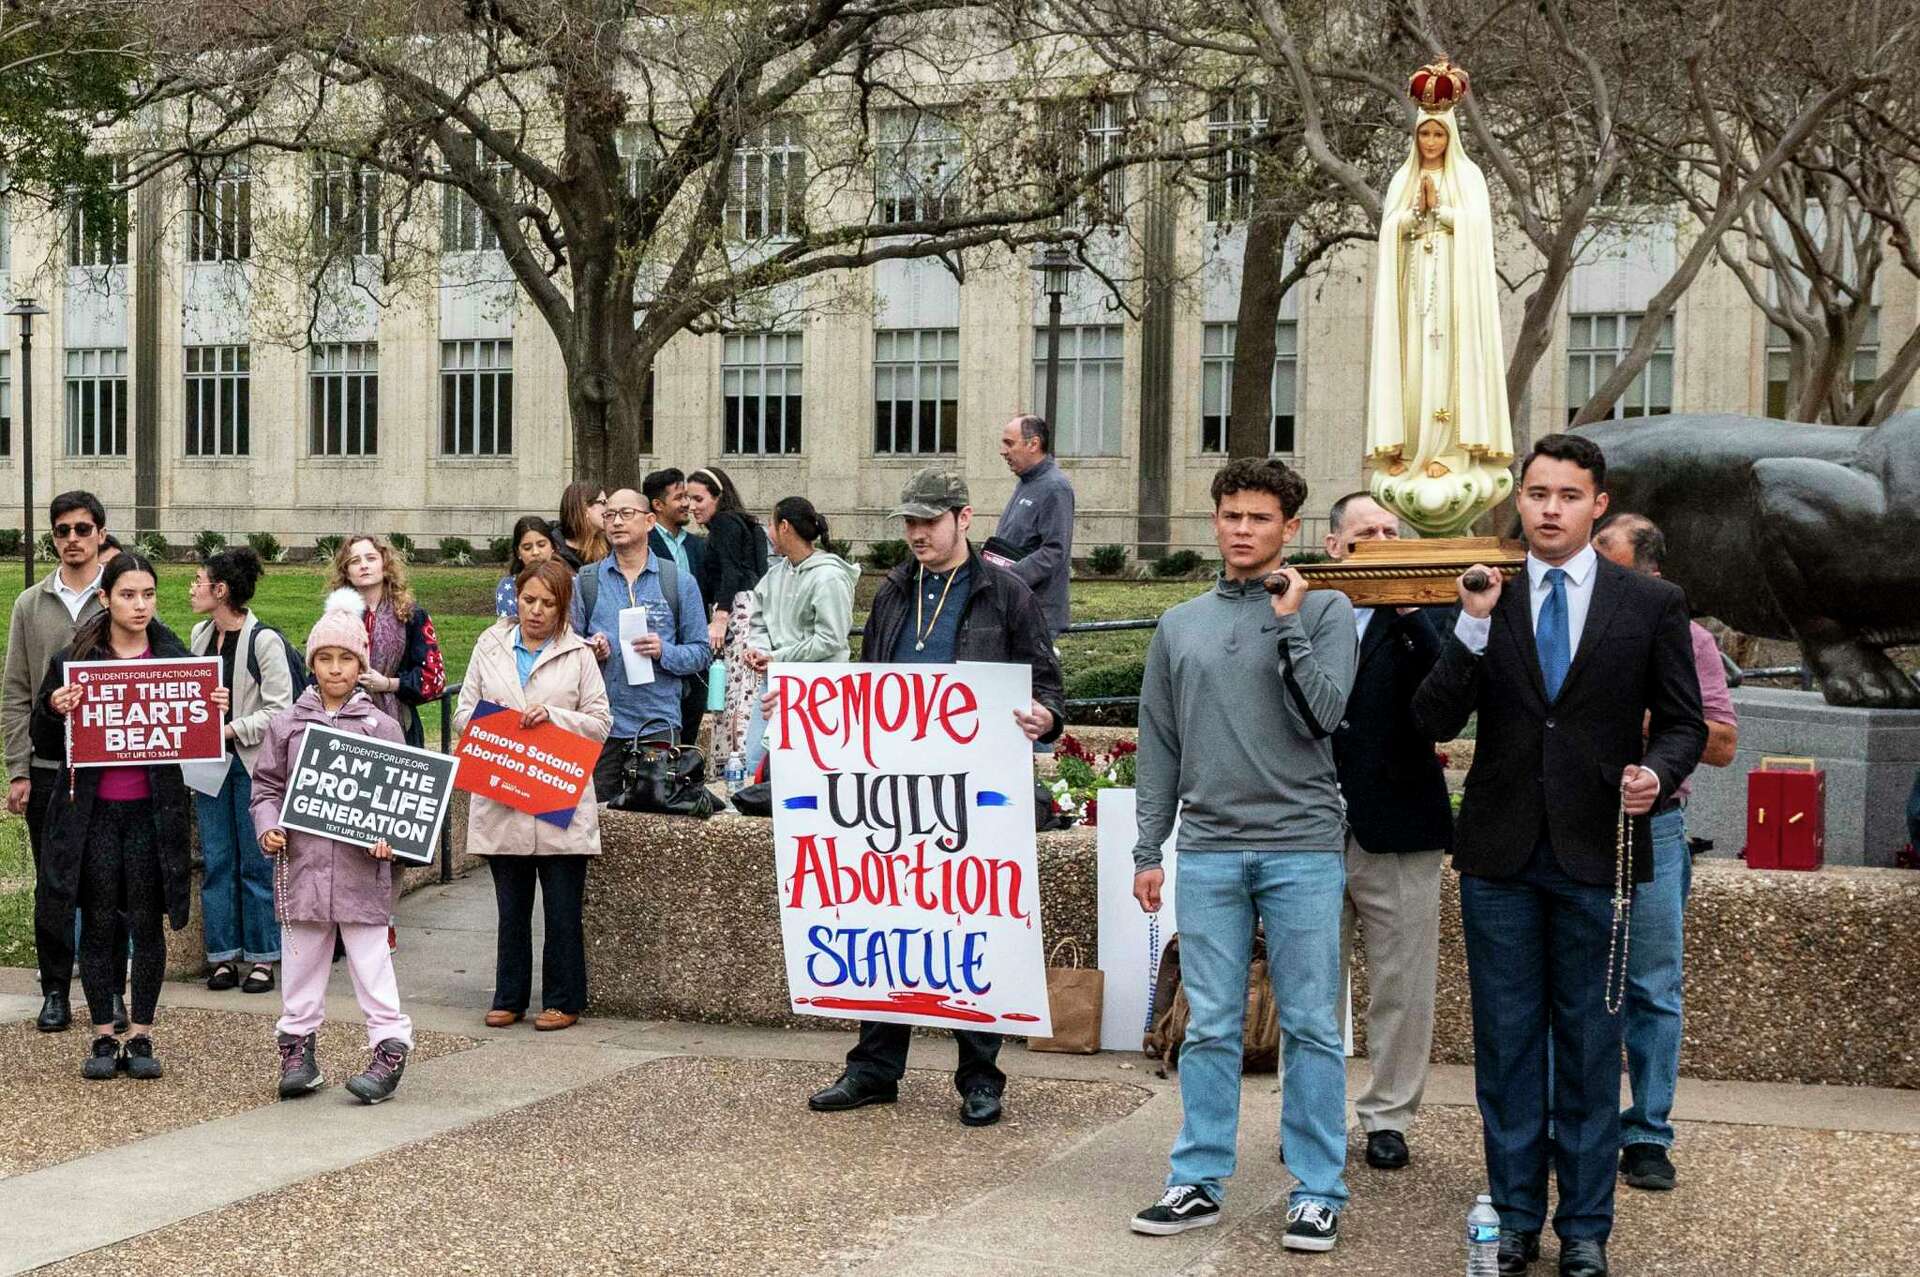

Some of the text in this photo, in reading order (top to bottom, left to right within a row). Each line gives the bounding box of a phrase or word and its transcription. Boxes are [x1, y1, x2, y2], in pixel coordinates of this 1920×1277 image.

[88, 681, 202, 702] LET THEIR
[89, 669, 212, 681] STUDENTSFORLIFEACTION.ORG
[82, 700, 209, 728] HEARTS
[105, 726, 187, 752] BEAT
[116, 752, 131, 760] TEXT
[132, 751, 146, 759] LIFE
[147, 751, 157, 759] TO
[339, 743, 430, 772] STUDENTSFORLIFE.ORG
[469, 725, 585, 778] Remove Satanic
[310, 749, 436, 794] I AM THE
[462, 742, 525, 773] Abortion
[526, 765, 577, 794] Statue
[295, 767, 439, 823] PRO-LIFE
[292, 795, 428, 843] GENERATION
[325, 823, 341, 833] TEXT
[341, 827, 356, 837] LIFE
[356, 831, 366, 839] TO
[785, 834, 1031, 921] Abortion
[806, 925, 992, 995] STATUE
